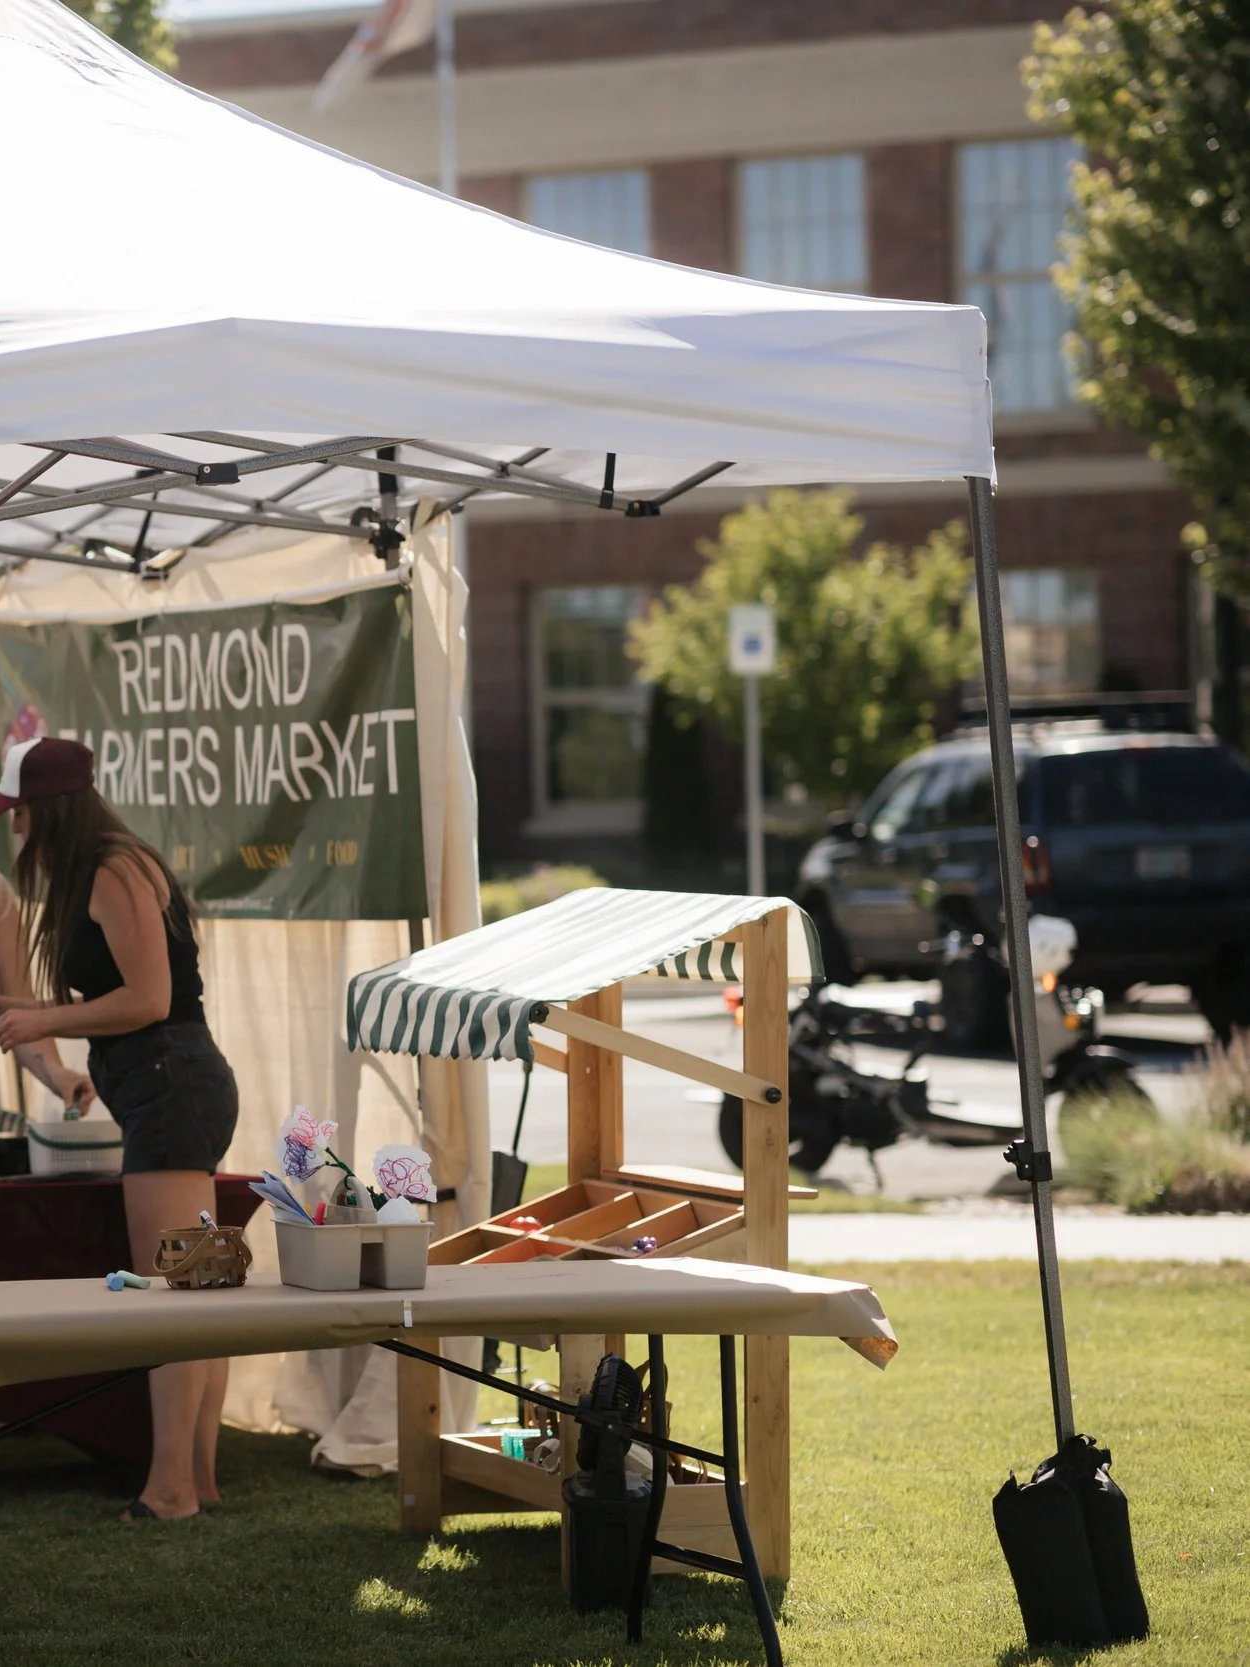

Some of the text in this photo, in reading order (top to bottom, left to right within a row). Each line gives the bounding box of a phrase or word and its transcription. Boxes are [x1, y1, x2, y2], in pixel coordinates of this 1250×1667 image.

[111, 623, 311, 715] REDMOND
[57, 708, 415, 808] RMERS MARKET
